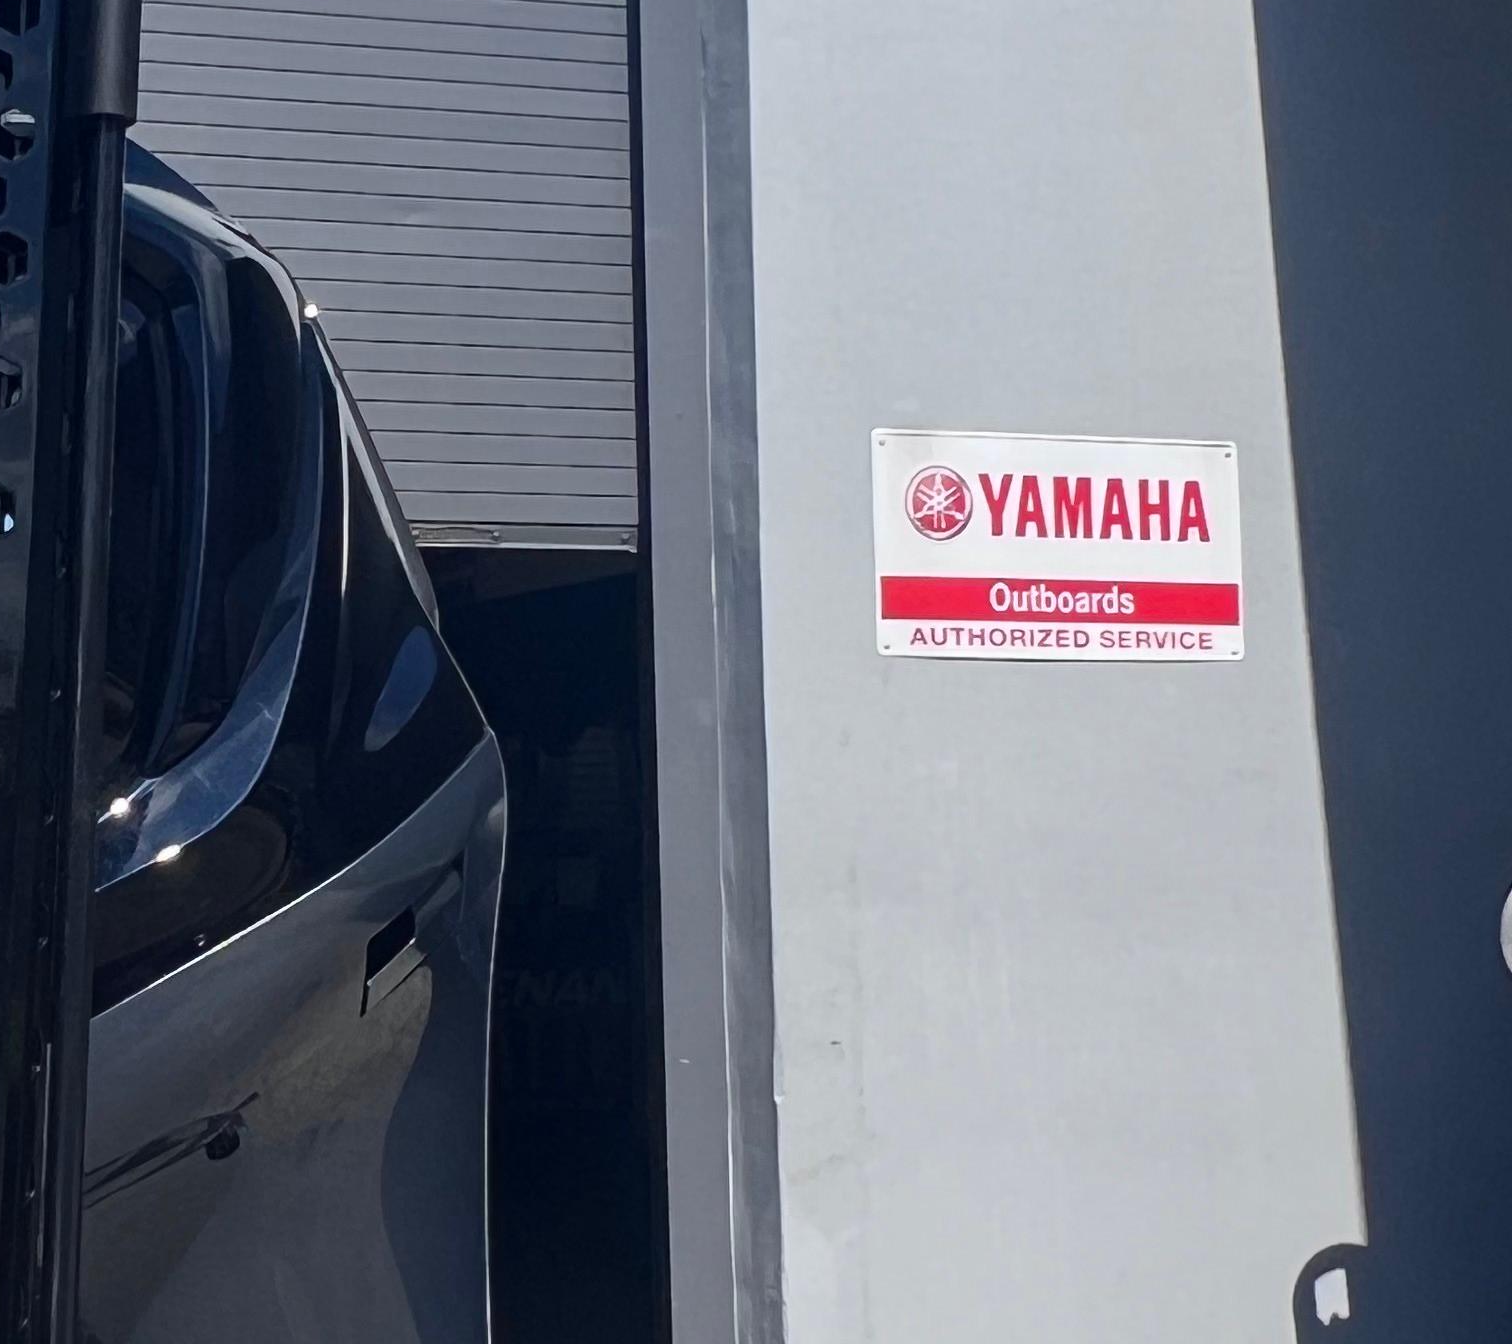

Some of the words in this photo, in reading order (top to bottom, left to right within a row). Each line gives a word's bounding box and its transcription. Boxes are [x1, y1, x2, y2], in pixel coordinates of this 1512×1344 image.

[977, 472, 1211, 543] YAMAHA
[988, 581, 1136, 616] Outboards
[909, 626, 1091, 649] AUTHORIZED
[1099, 629, 1214, 651] SERVICE
